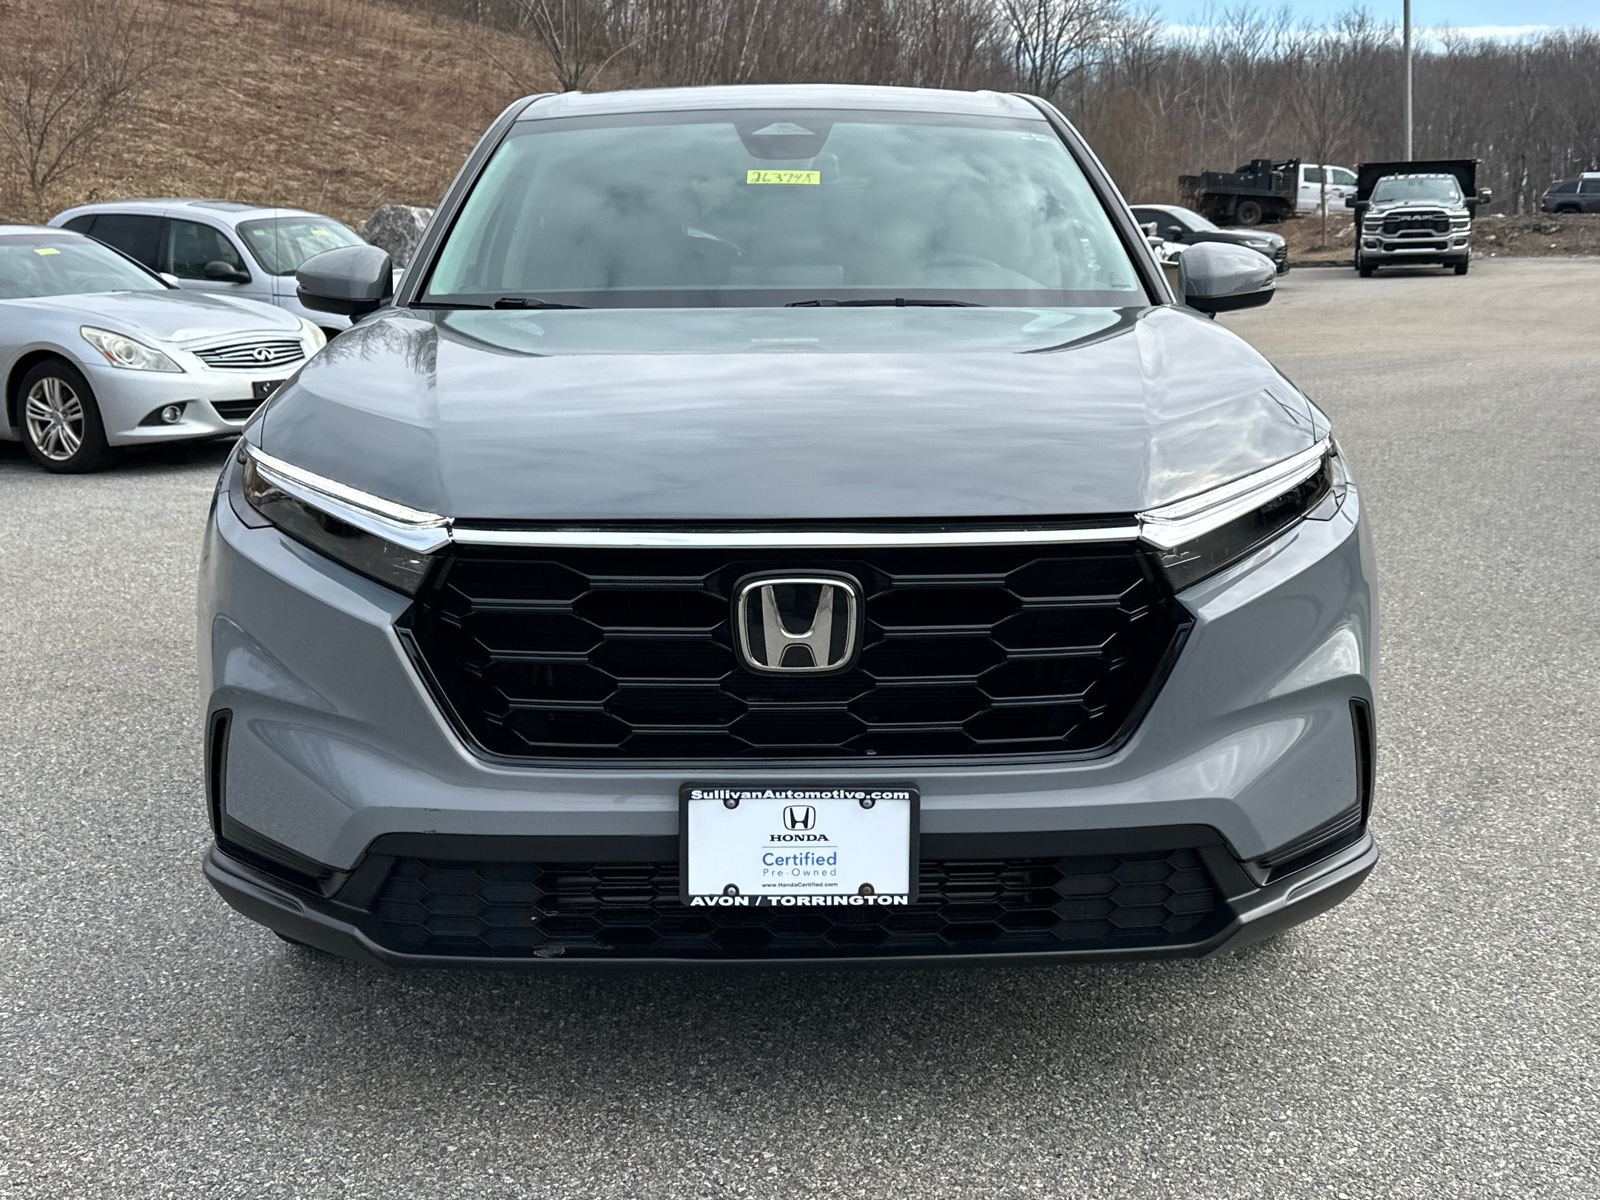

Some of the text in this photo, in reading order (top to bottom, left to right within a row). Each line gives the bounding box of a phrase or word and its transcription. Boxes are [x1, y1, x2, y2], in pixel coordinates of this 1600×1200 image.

[691, 789, 909, 800] SullivanAutomotive.com
[769, 834, 829, 842] HONDA
[762, 851, 837, 866] Certified
[763, 868, 837, 877] Pre-Owned
[690, 896, 749, 906] AVON
[767, 895, 908, 906] TORRINGTON
